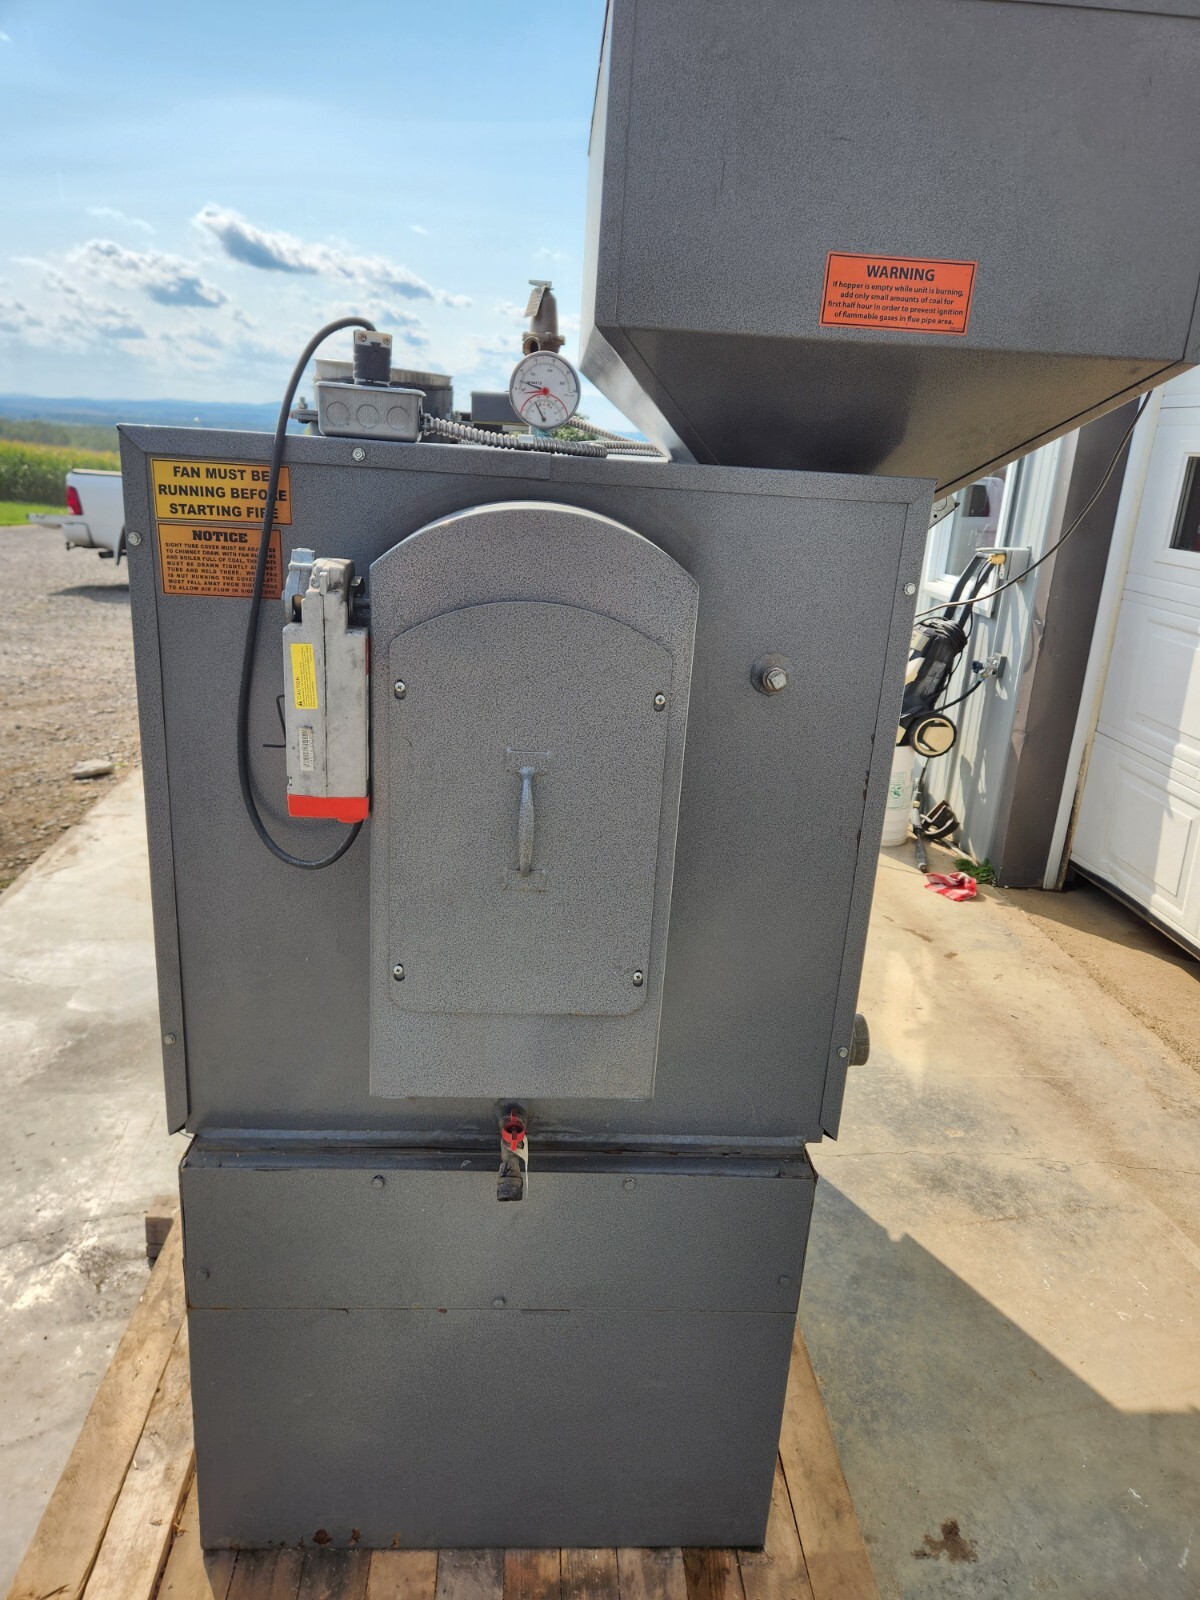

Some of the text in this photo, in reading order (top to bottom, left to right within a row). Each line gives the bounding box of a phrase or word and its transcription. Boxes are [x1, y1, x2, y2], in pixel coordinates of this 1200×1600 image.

[866, 264, 935, 282] WARNING
[838, 280, 864, 290] hopper
[843, 311, 878, 319] flammable
[173, 466, 270, 481] FAN MUST BE
[158, 484, 226, 498] RUNNING
[170, 503, 242, 517] STARTING
[192, 530, 248, 543] NOTICE
